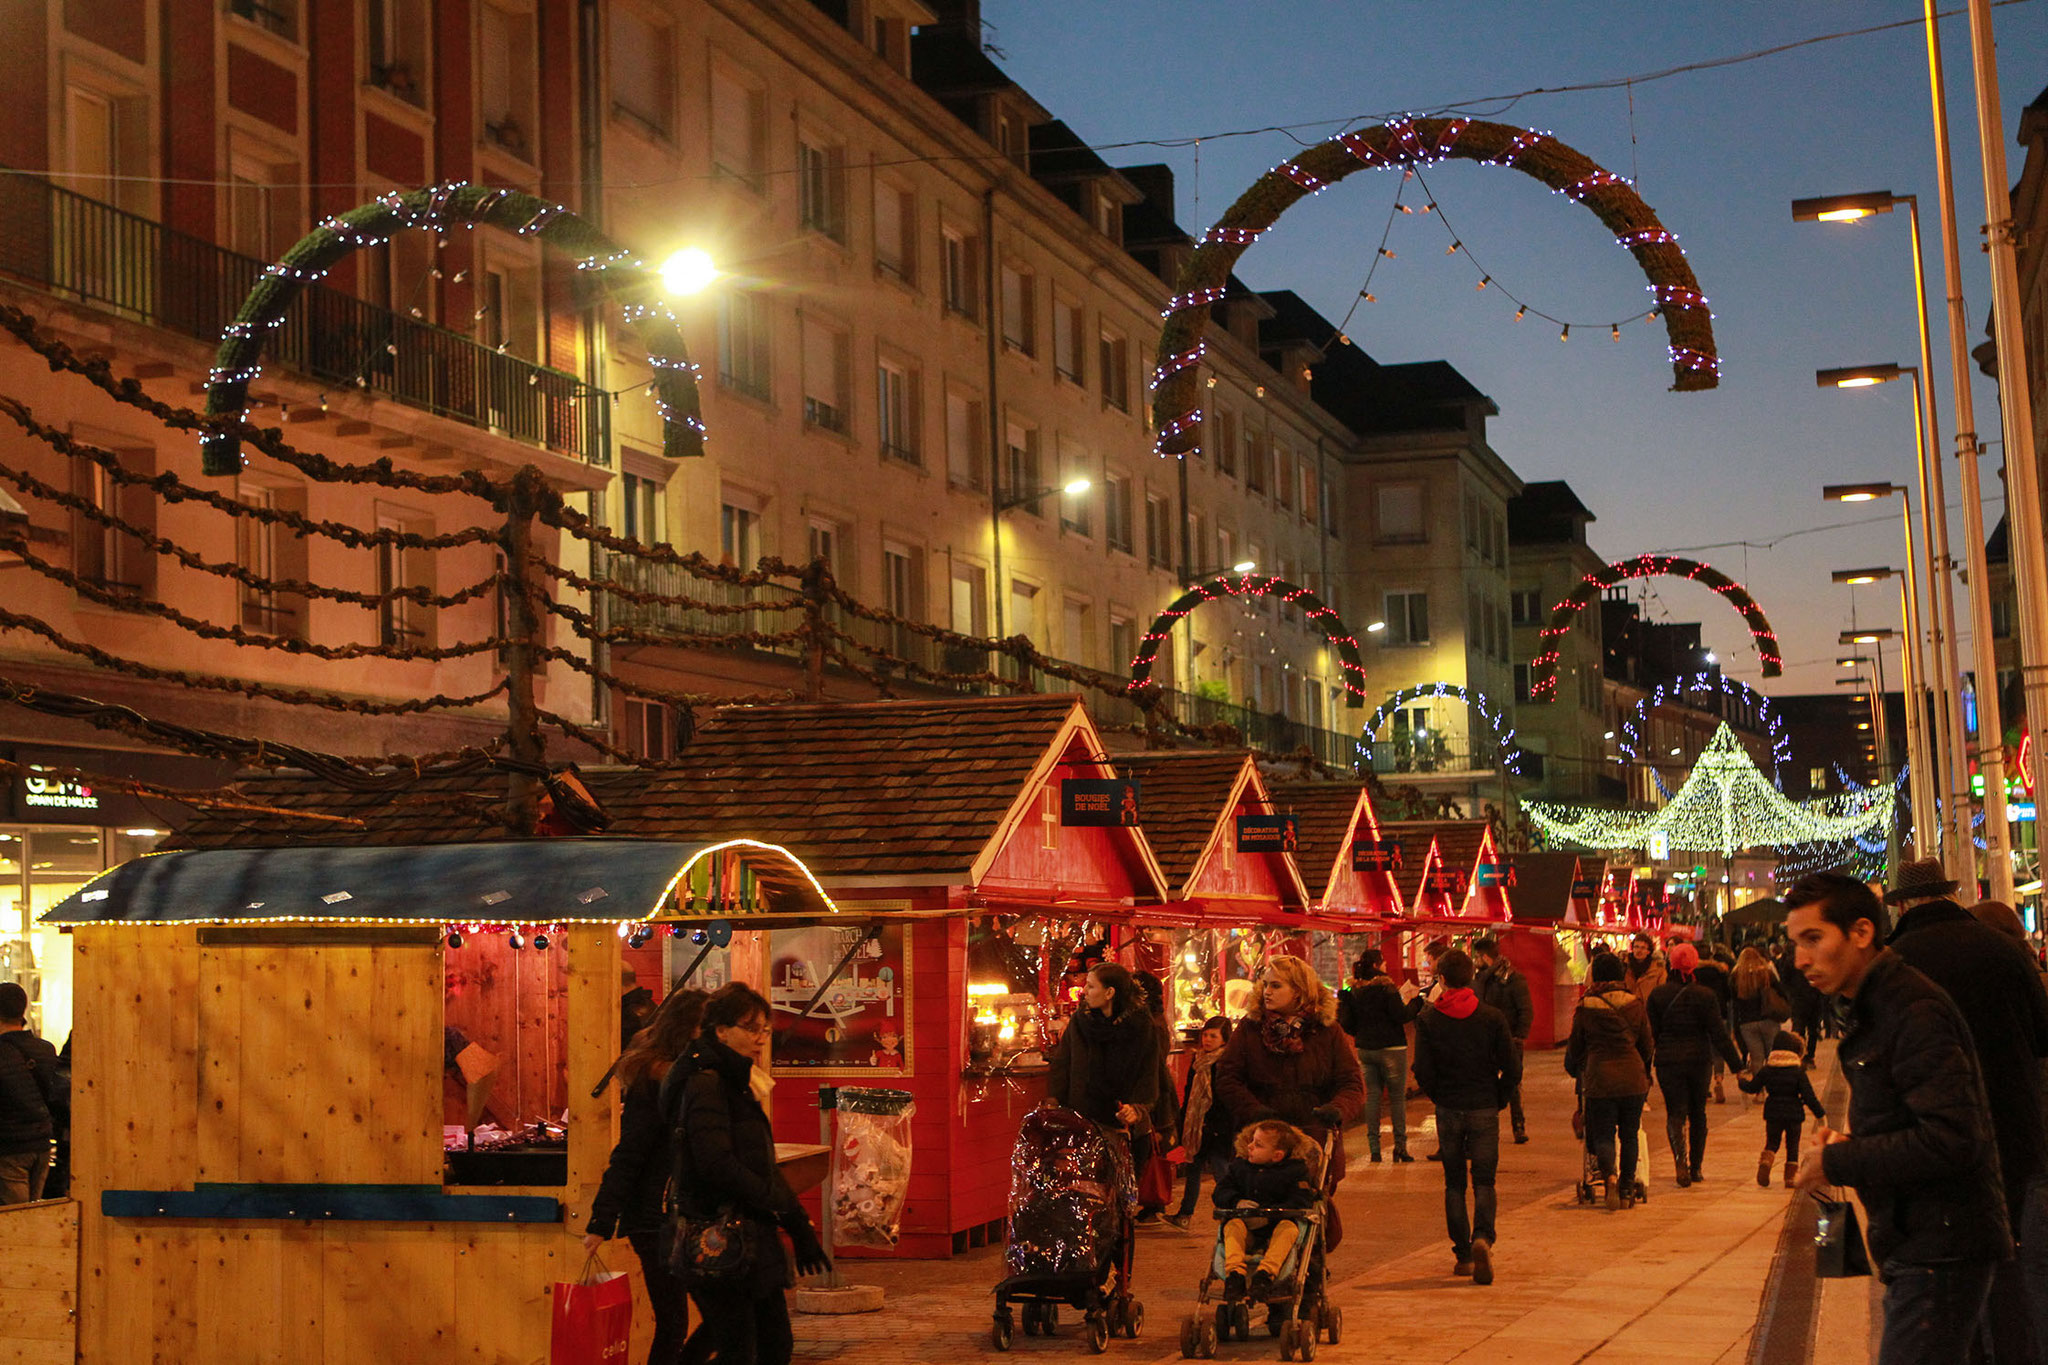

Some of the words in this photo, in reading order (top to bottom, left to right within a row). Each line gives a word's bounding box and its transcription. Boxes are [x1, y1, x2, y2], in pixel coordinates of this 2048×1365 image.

[54, 795, 67, 807] DE
[1074, 793, 1111, 802] BOUGIES
[1074, 802, 1087, 811] DE
[833, 928, 868, 943] MARCH
